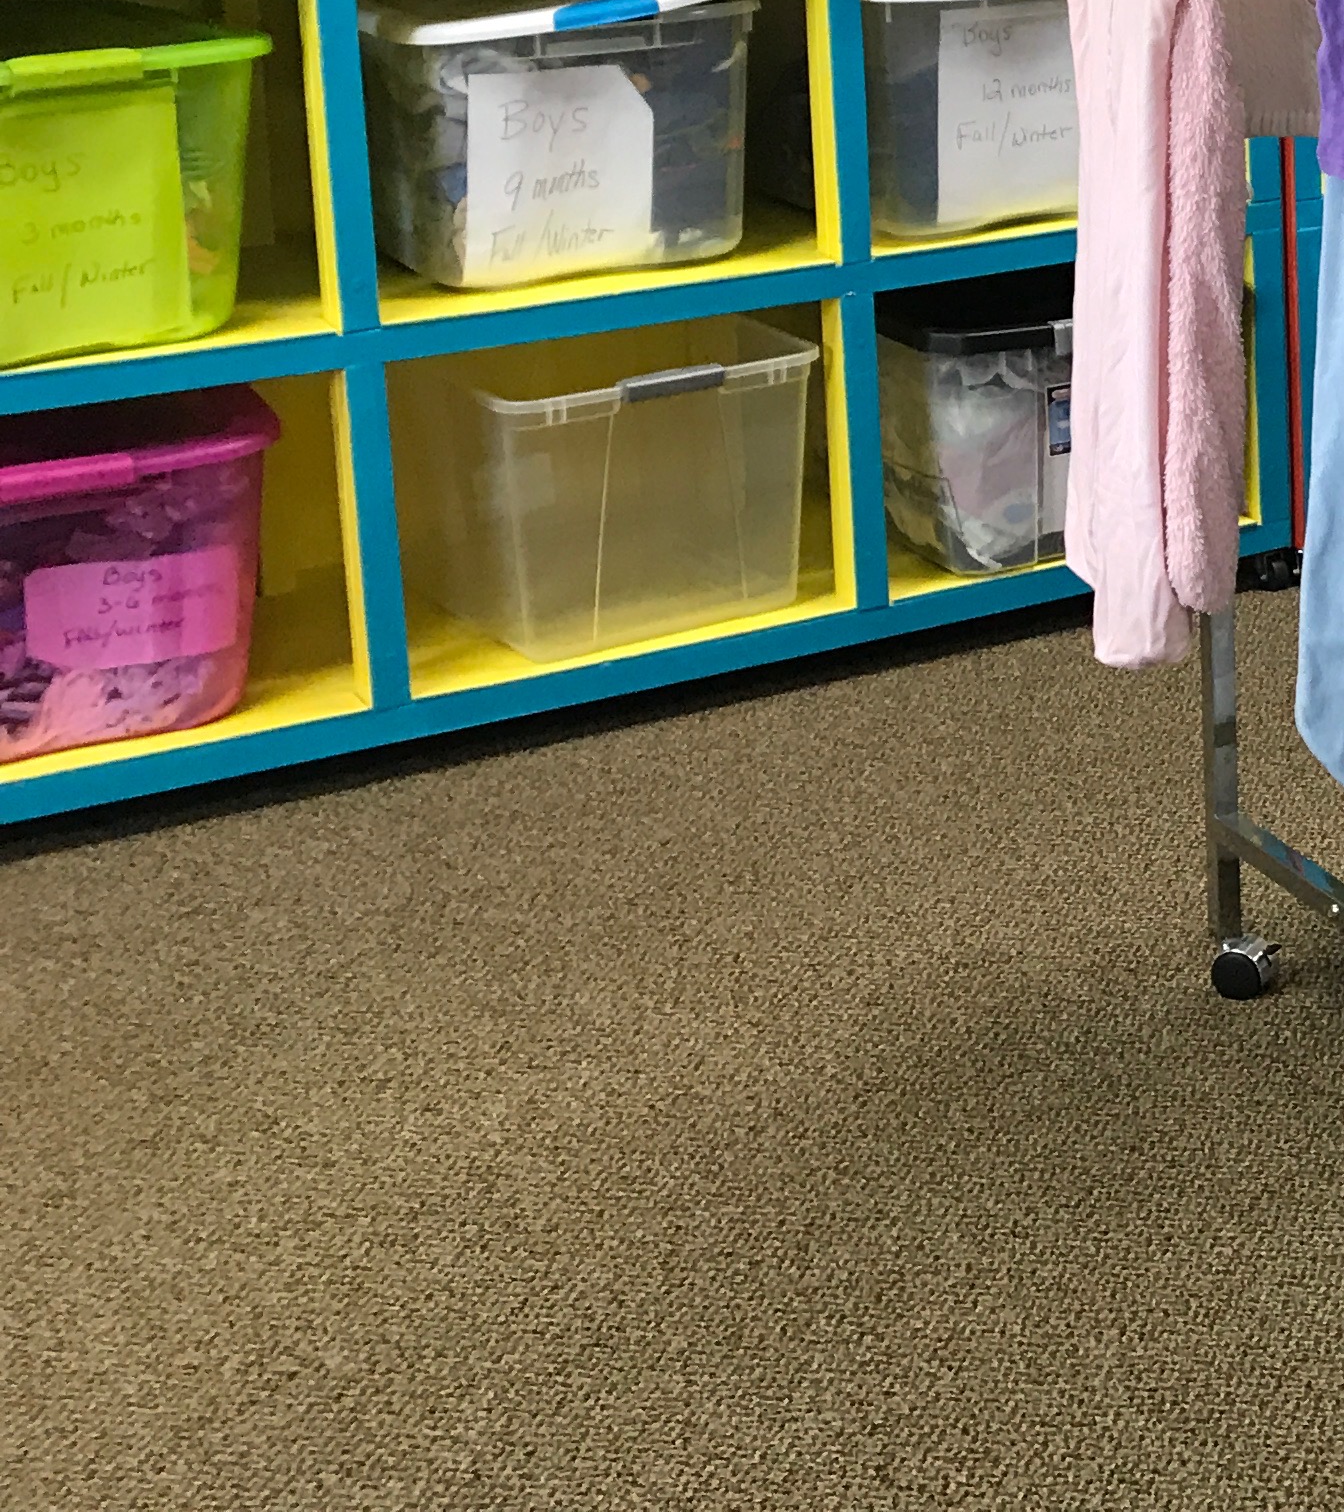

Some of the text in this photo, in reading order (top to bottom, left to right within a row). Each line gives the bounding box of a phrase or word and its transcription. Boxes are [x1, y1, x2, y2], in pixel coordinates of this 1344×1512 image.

[962, 22, 1013, 57] Boys
[1010, 76, 1072, 99] months
[498, 99, 589, 153] Boys
[504, 158, 600, 211] 9 months
[103, 566, 163, 592] Boys
